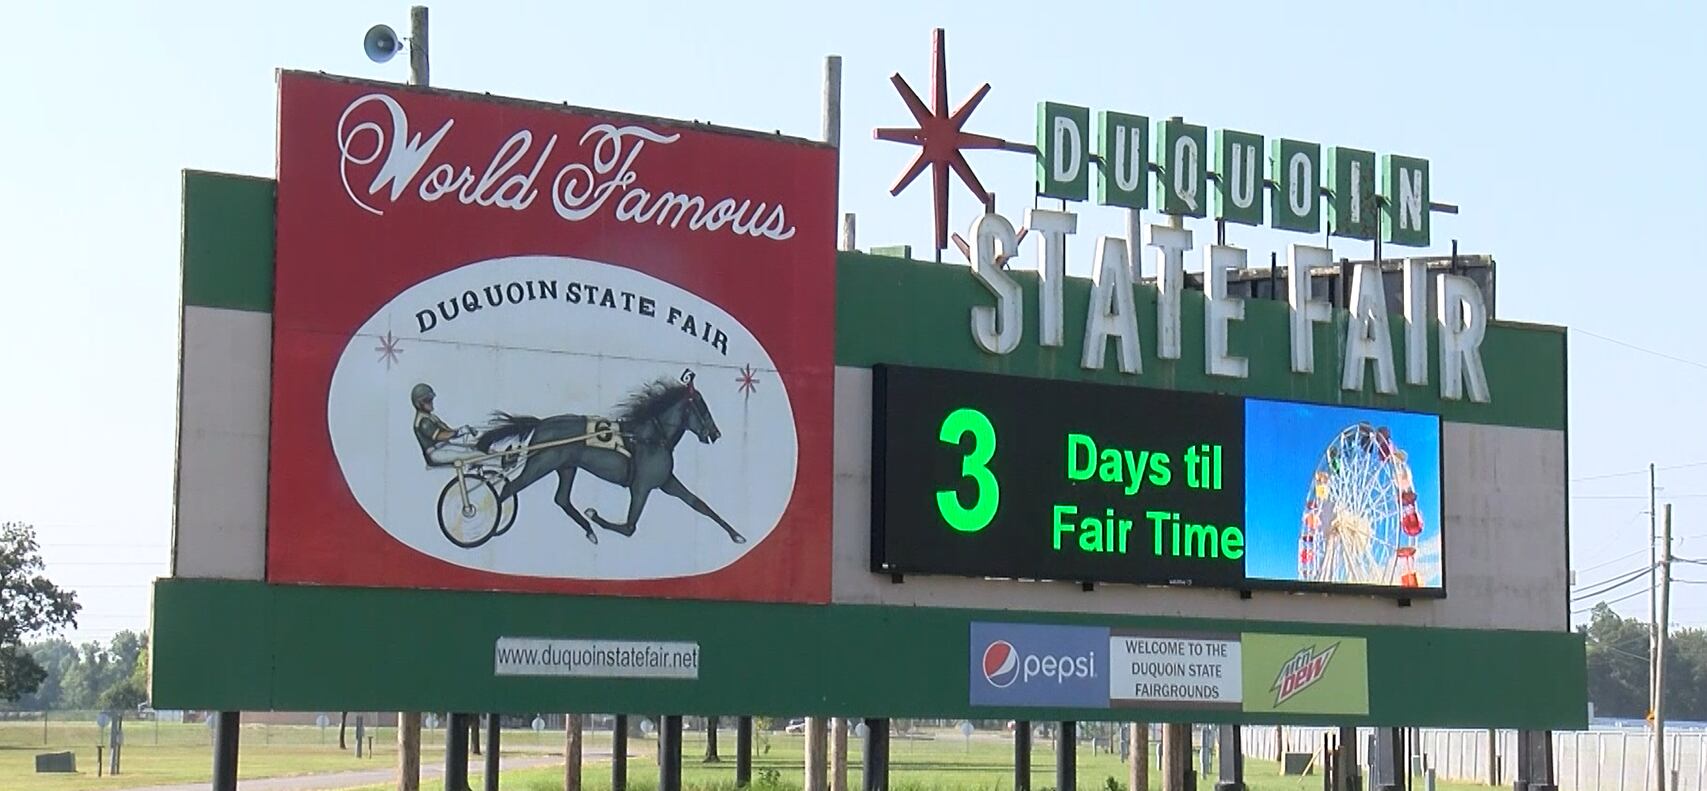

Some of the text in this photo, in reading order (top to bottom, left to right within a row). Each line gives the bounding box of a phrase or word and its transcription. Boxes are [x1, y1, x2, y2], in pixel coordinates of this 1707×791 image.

[337, 93, 796, 241] World Famous
[1053, 116, 1422, 231] DUQUOIN
[416, 279, 729, 355] DUQUOIN STATE FAIR
[970, 208, 1491, 404] STATE FAIR
[936, 408, 1000, 532] 3
[1067, 434, 1222, 495] Days til
[1052, 505, 1244, 560] Fair Time
[498, 644, 697, 670] www.duquoinstatefair.net
[1023, 651, 1095, 684] pepsi
[1125, 640, 1228, 657] WELCOME TO THE
[1131, 661, 1222, 679] DUQUOIN STATE
[1135, 684, 1220, 700] FAIRGROUNDS
